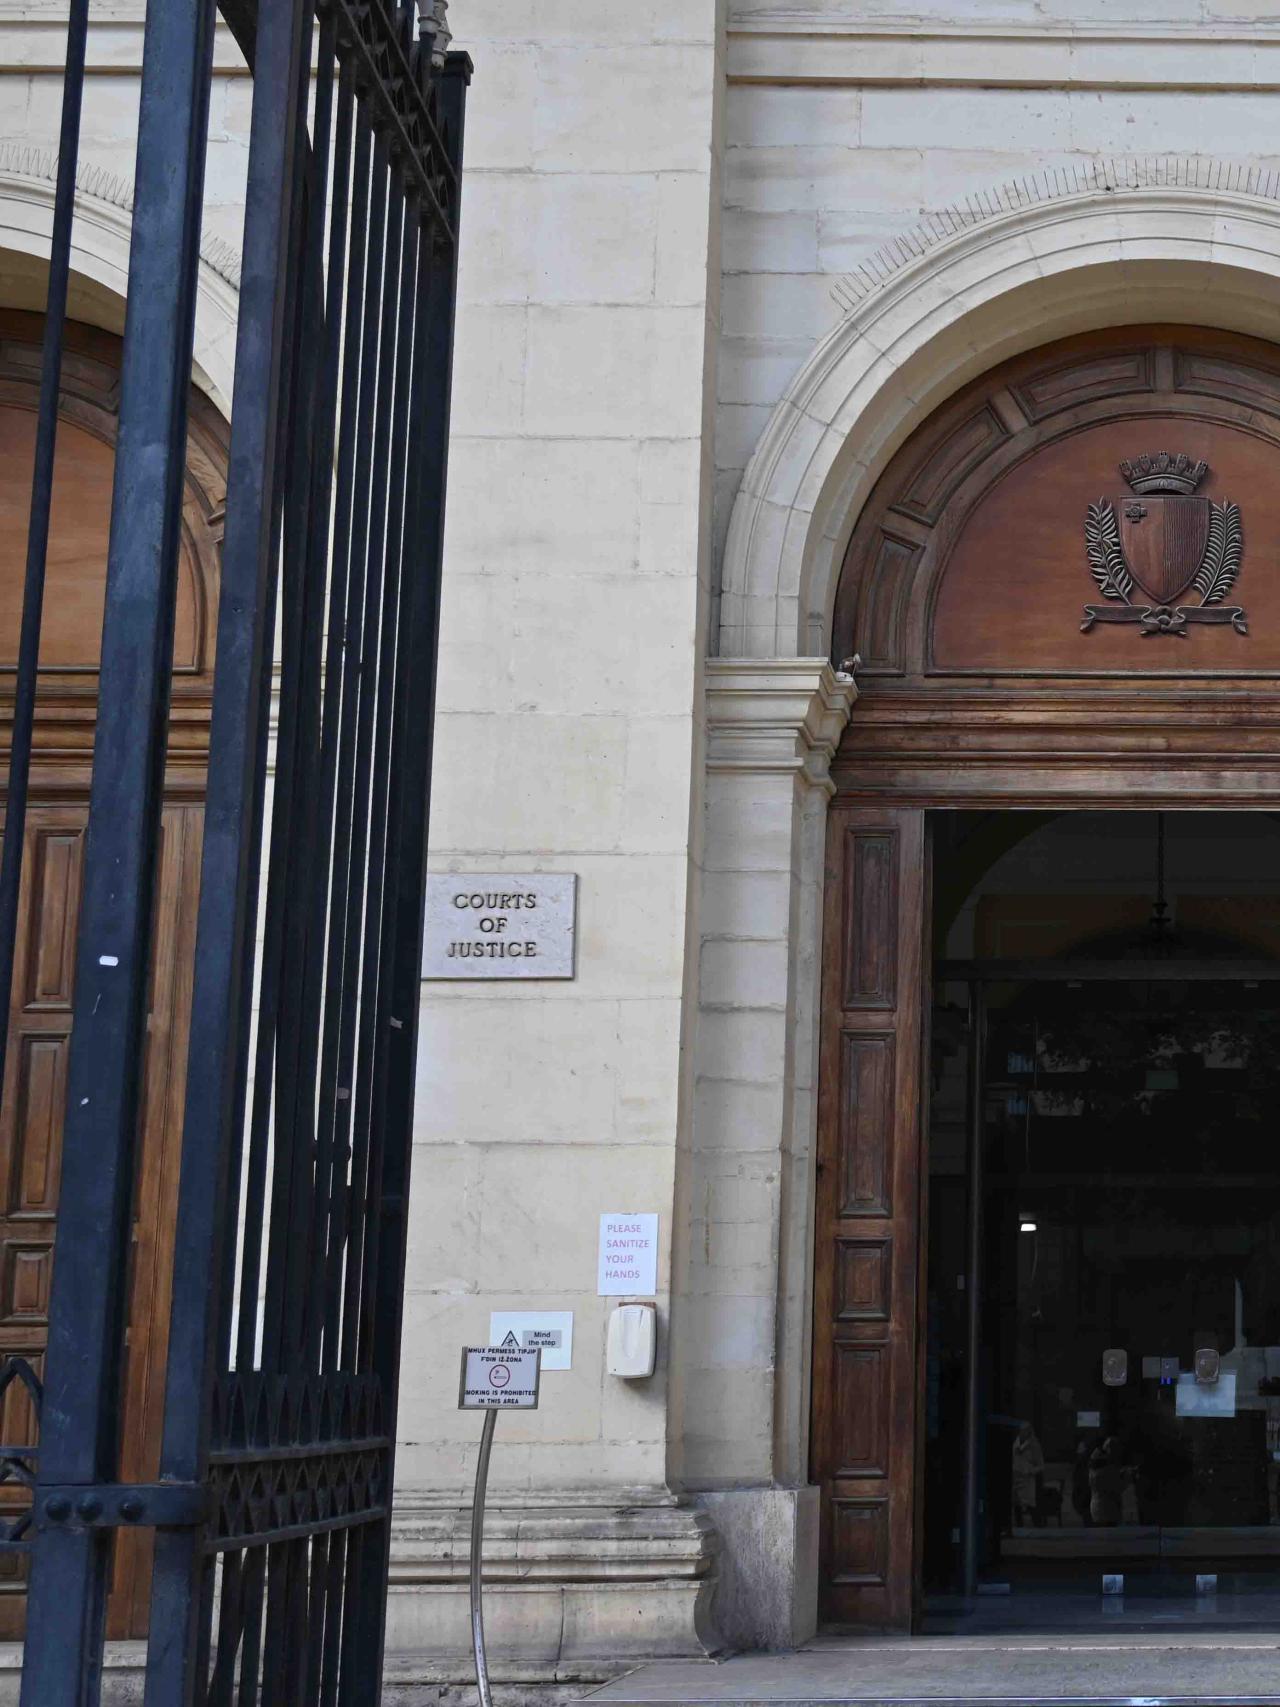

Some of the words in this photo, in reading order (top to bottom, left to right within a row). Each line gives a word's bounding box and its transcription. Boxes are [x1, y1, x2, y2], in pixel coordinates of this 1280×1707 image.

[454, 893, 537, 909] COURTS
[479, 917, 508, 933] OF
[447, 941, 537, 958] JUSTICE
[607, 1224, 641, 1233] PLEASE
[606, 1239, 650, 1248] SANITIZE
[606, 1254, 634, 1264] YOUR
[605, 1269, 640, 1280] HANDS
